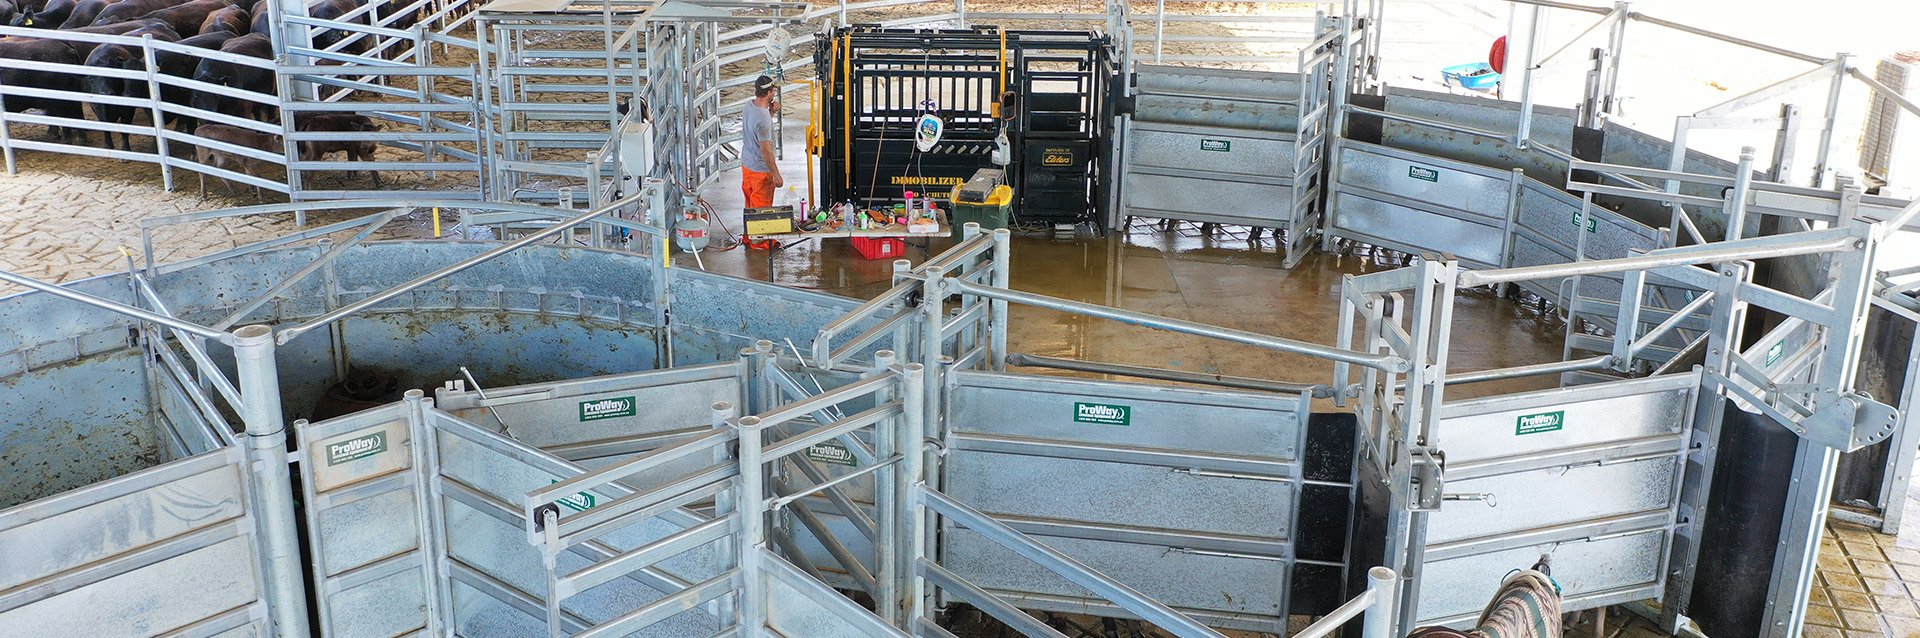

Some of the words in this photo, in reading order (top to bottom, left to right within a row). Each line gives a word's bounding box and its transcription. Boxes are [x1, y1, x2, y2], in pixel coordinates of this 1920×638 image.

[891, 176, 964, 185] IMMOBILIZER
[583, 400, 624, 412] ProWay
[1079, 404, 1119, 419] ProWay
[1521, 414, 1555, 427] ProWay
[331, 437, 374, 455] ProWay
[810, 445, 846, 460] ProWay
